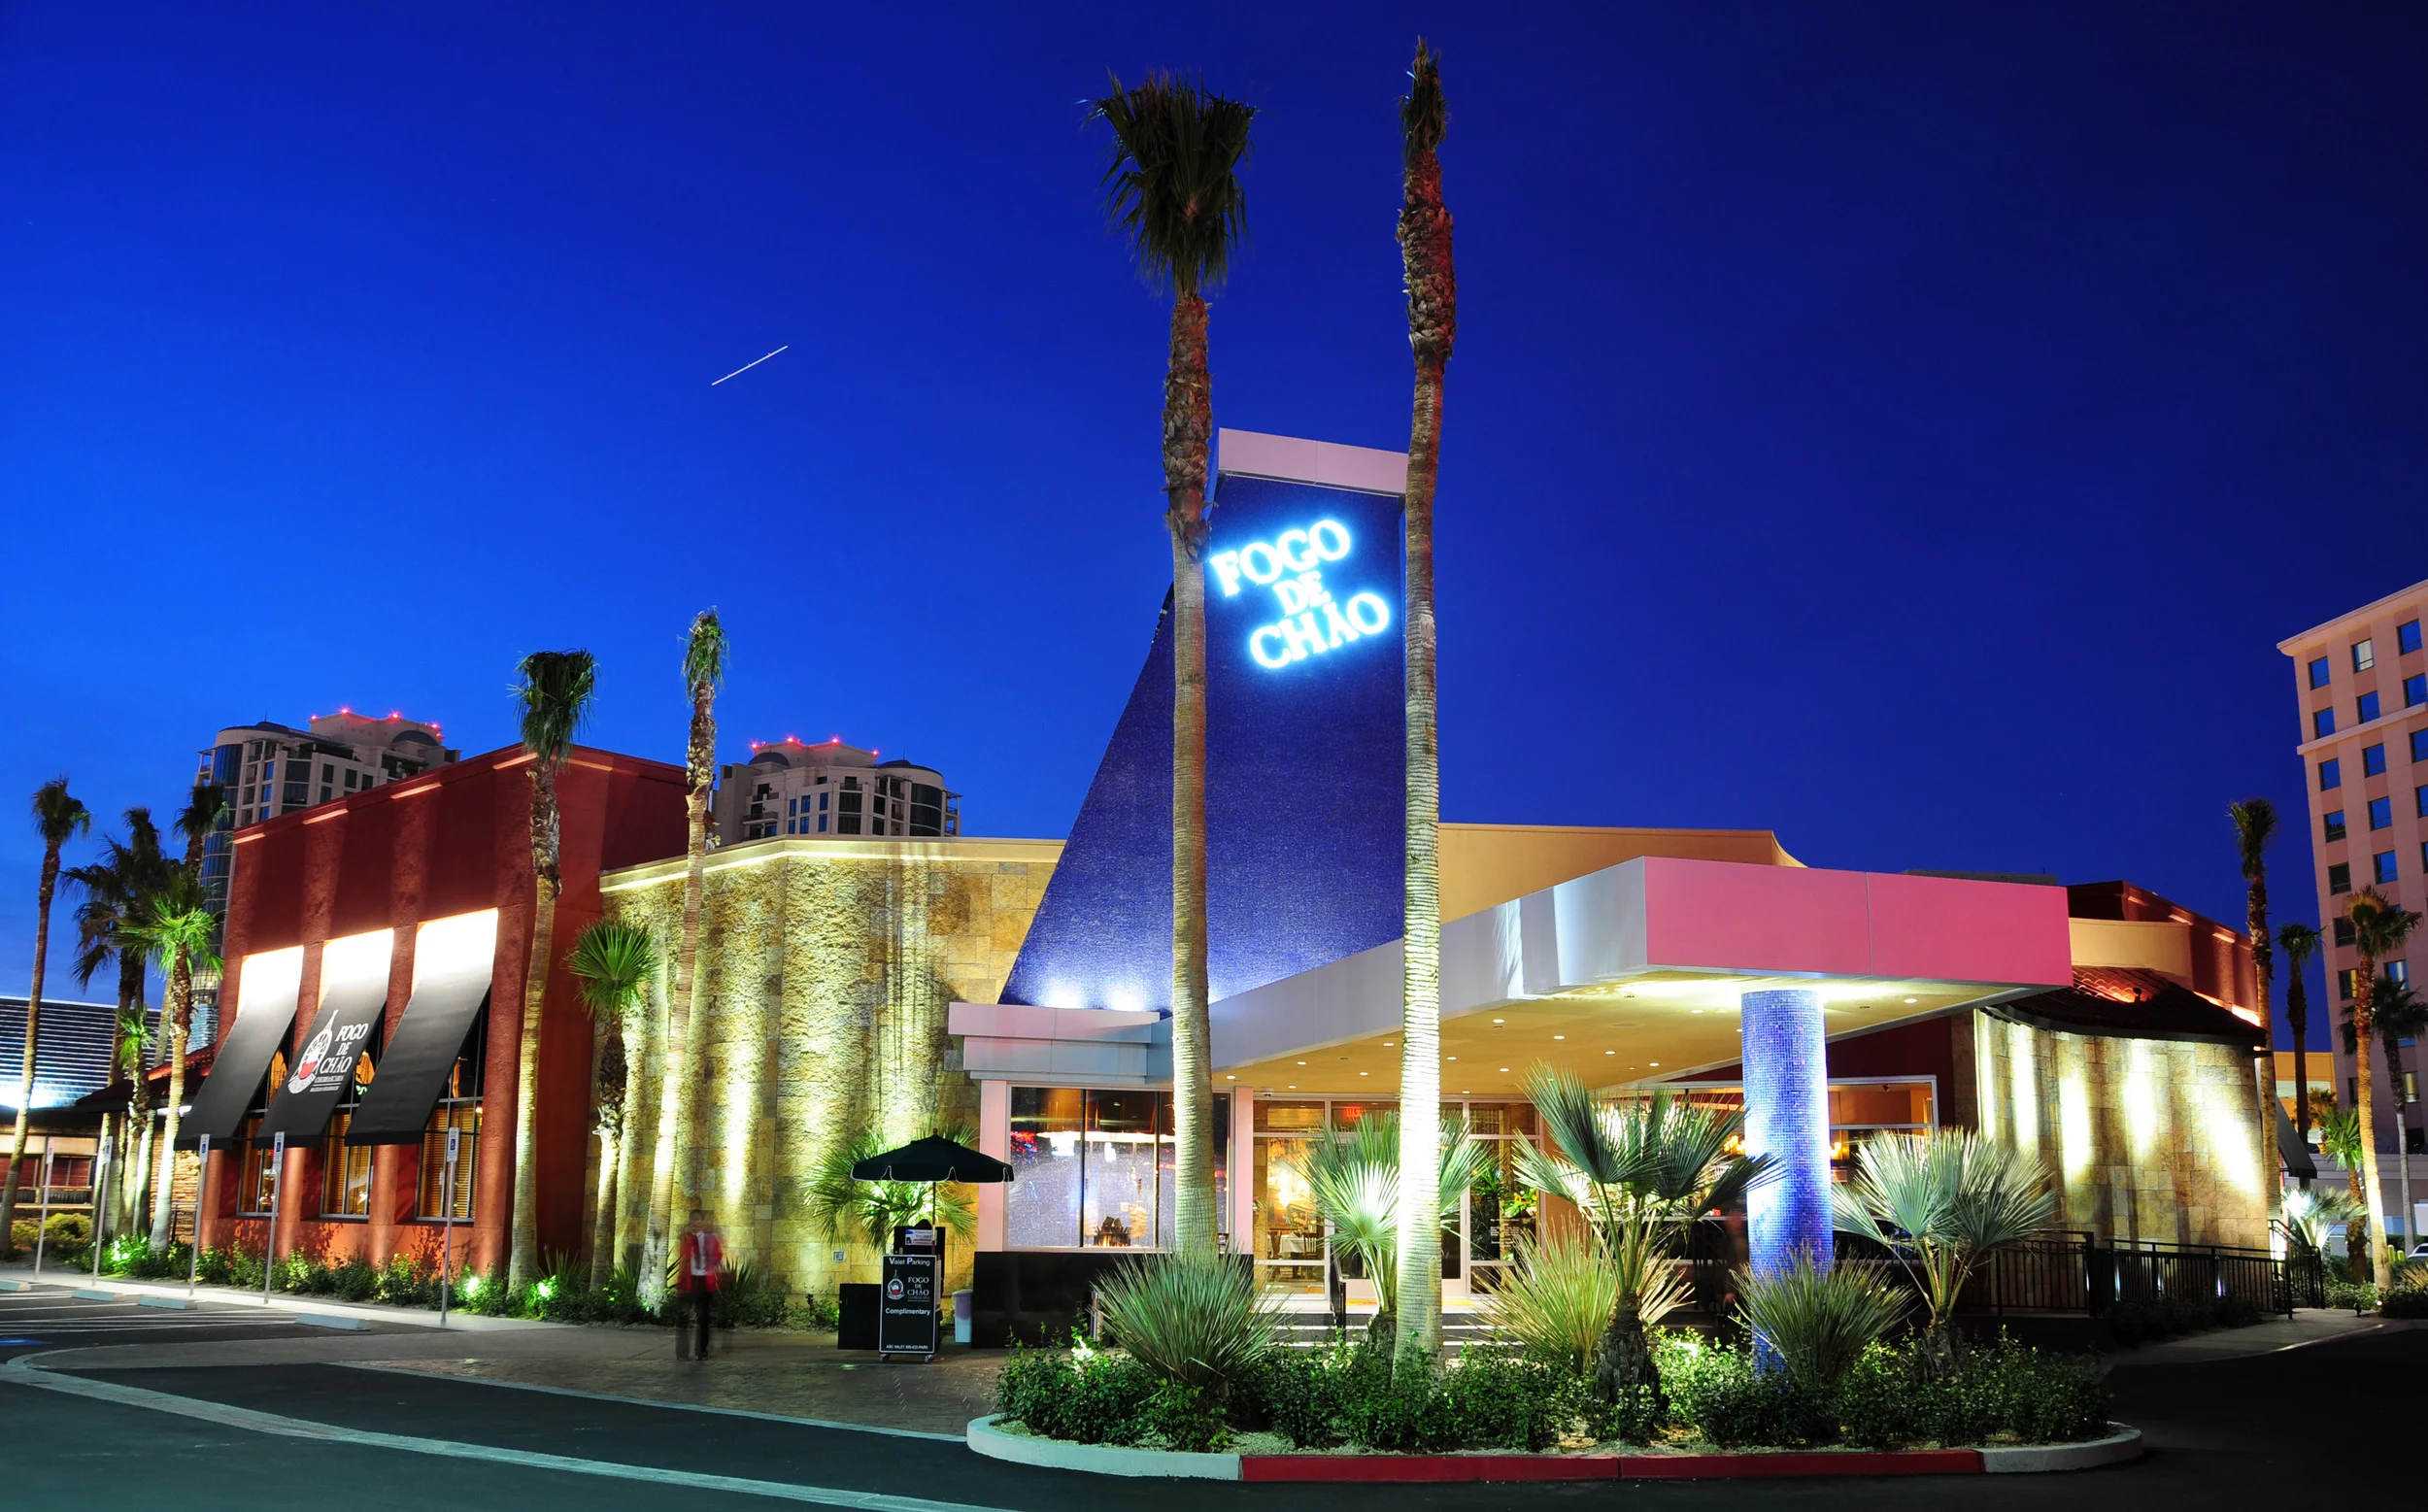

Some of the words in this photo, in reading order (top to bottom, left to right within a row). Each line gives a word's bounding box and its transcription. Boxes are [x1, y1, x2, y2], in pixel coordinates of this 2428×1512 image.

[1210, 520, 1351, 597] FOGO
[1272, 570, 1331, 618] DE
[334, 1023, 369, 1042] FOGO
[335, 1042, 353, 1056] DE
[889, 1257, 905, 1265] Valet
[906, 1257, 930, 1266] Parking
[885, 1307, 930, 1316] Complimentary
